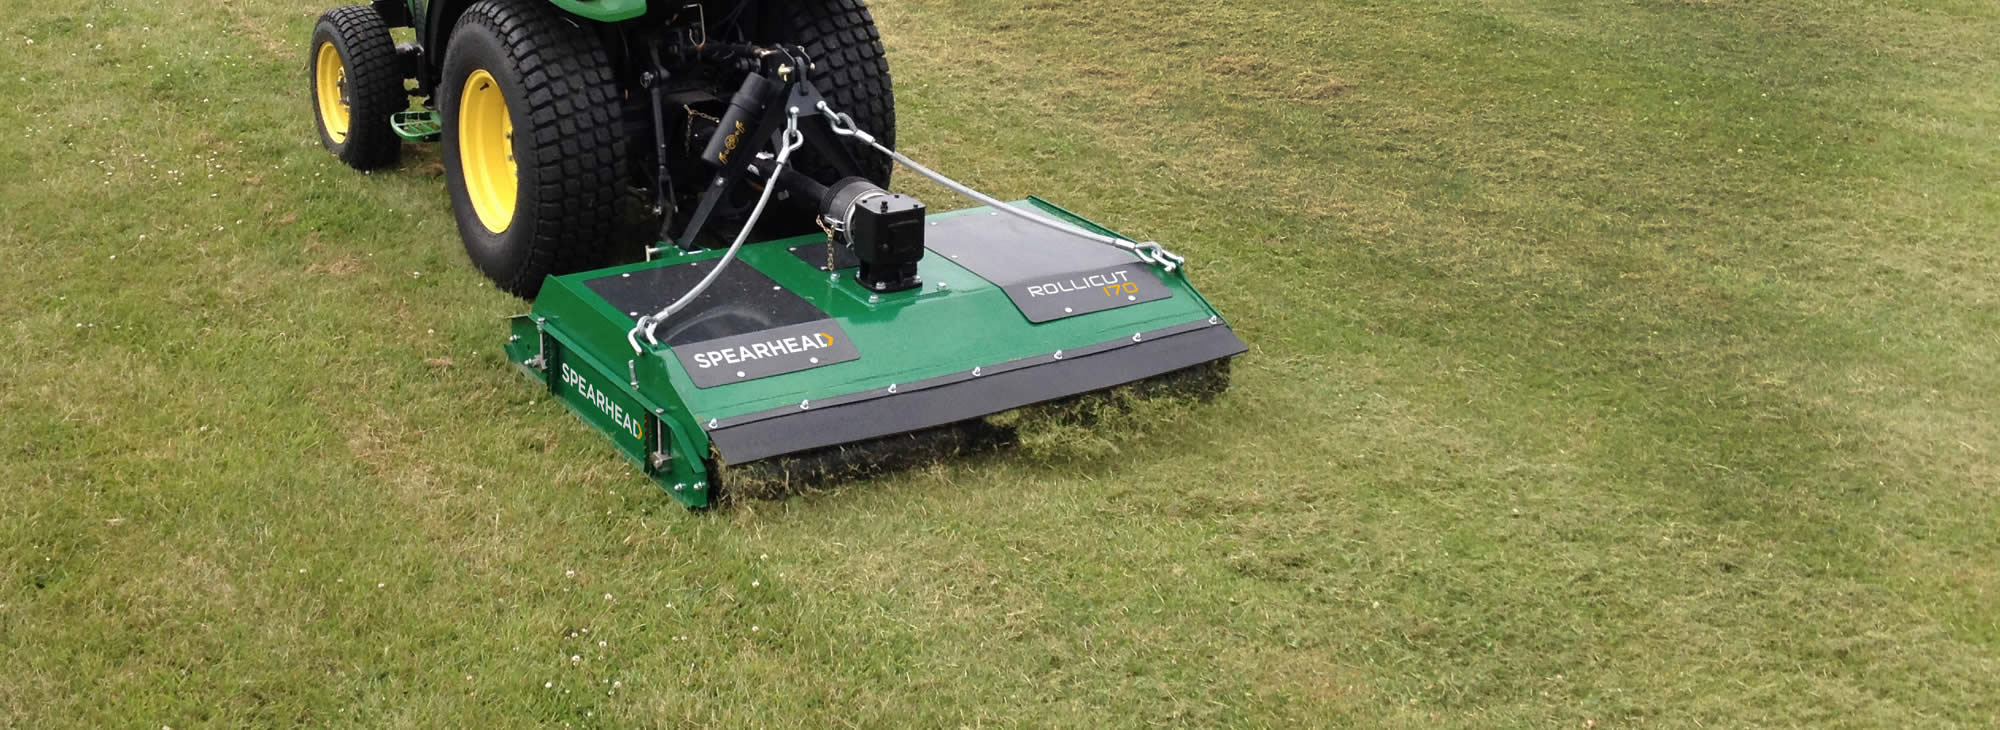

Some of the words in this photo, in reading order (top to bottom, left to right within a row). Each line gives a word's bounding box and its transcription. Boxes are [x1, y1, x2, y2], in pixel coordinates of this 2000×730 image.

[1027, 270, 1128, 297] ROLLICUT
[1103, 282, 1139, 296] 170
[694, 332, 834, 368] SPEARHEAD
[562, 363, 642, 440] SPEARHEAD
